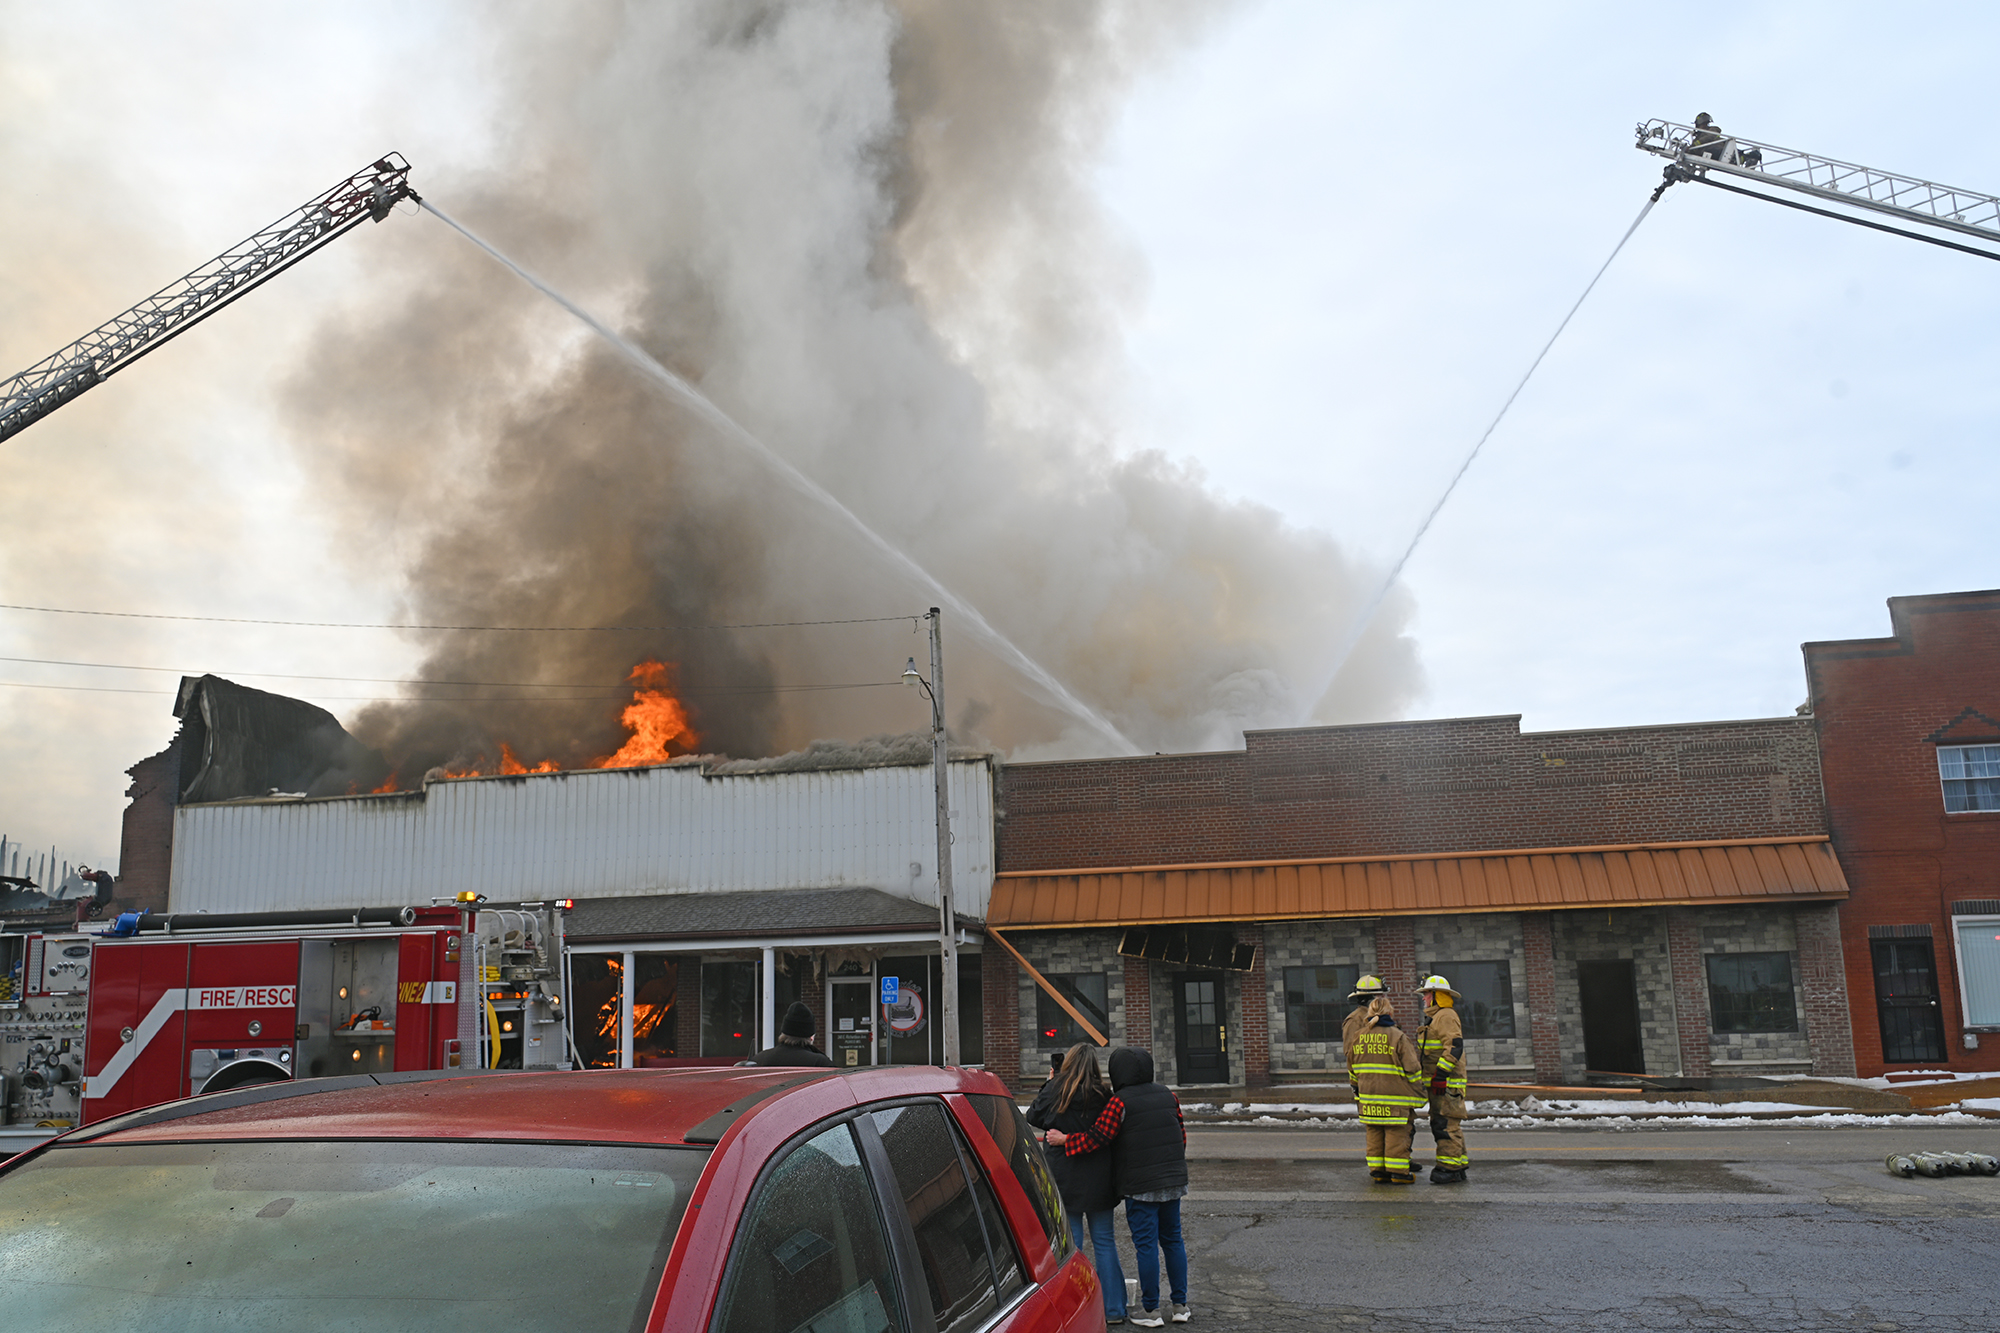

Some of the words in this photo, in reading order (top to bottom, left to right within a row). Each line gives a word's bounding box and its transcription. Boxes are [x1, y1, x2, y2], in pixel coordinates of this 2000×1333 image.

[844, 964, 858, 972] 240
[445, 986, 452, 999] E
[1359, 1033, 1388, 1044] PUXICO
[1362, 1105, 1391, 1116] GARRIS
